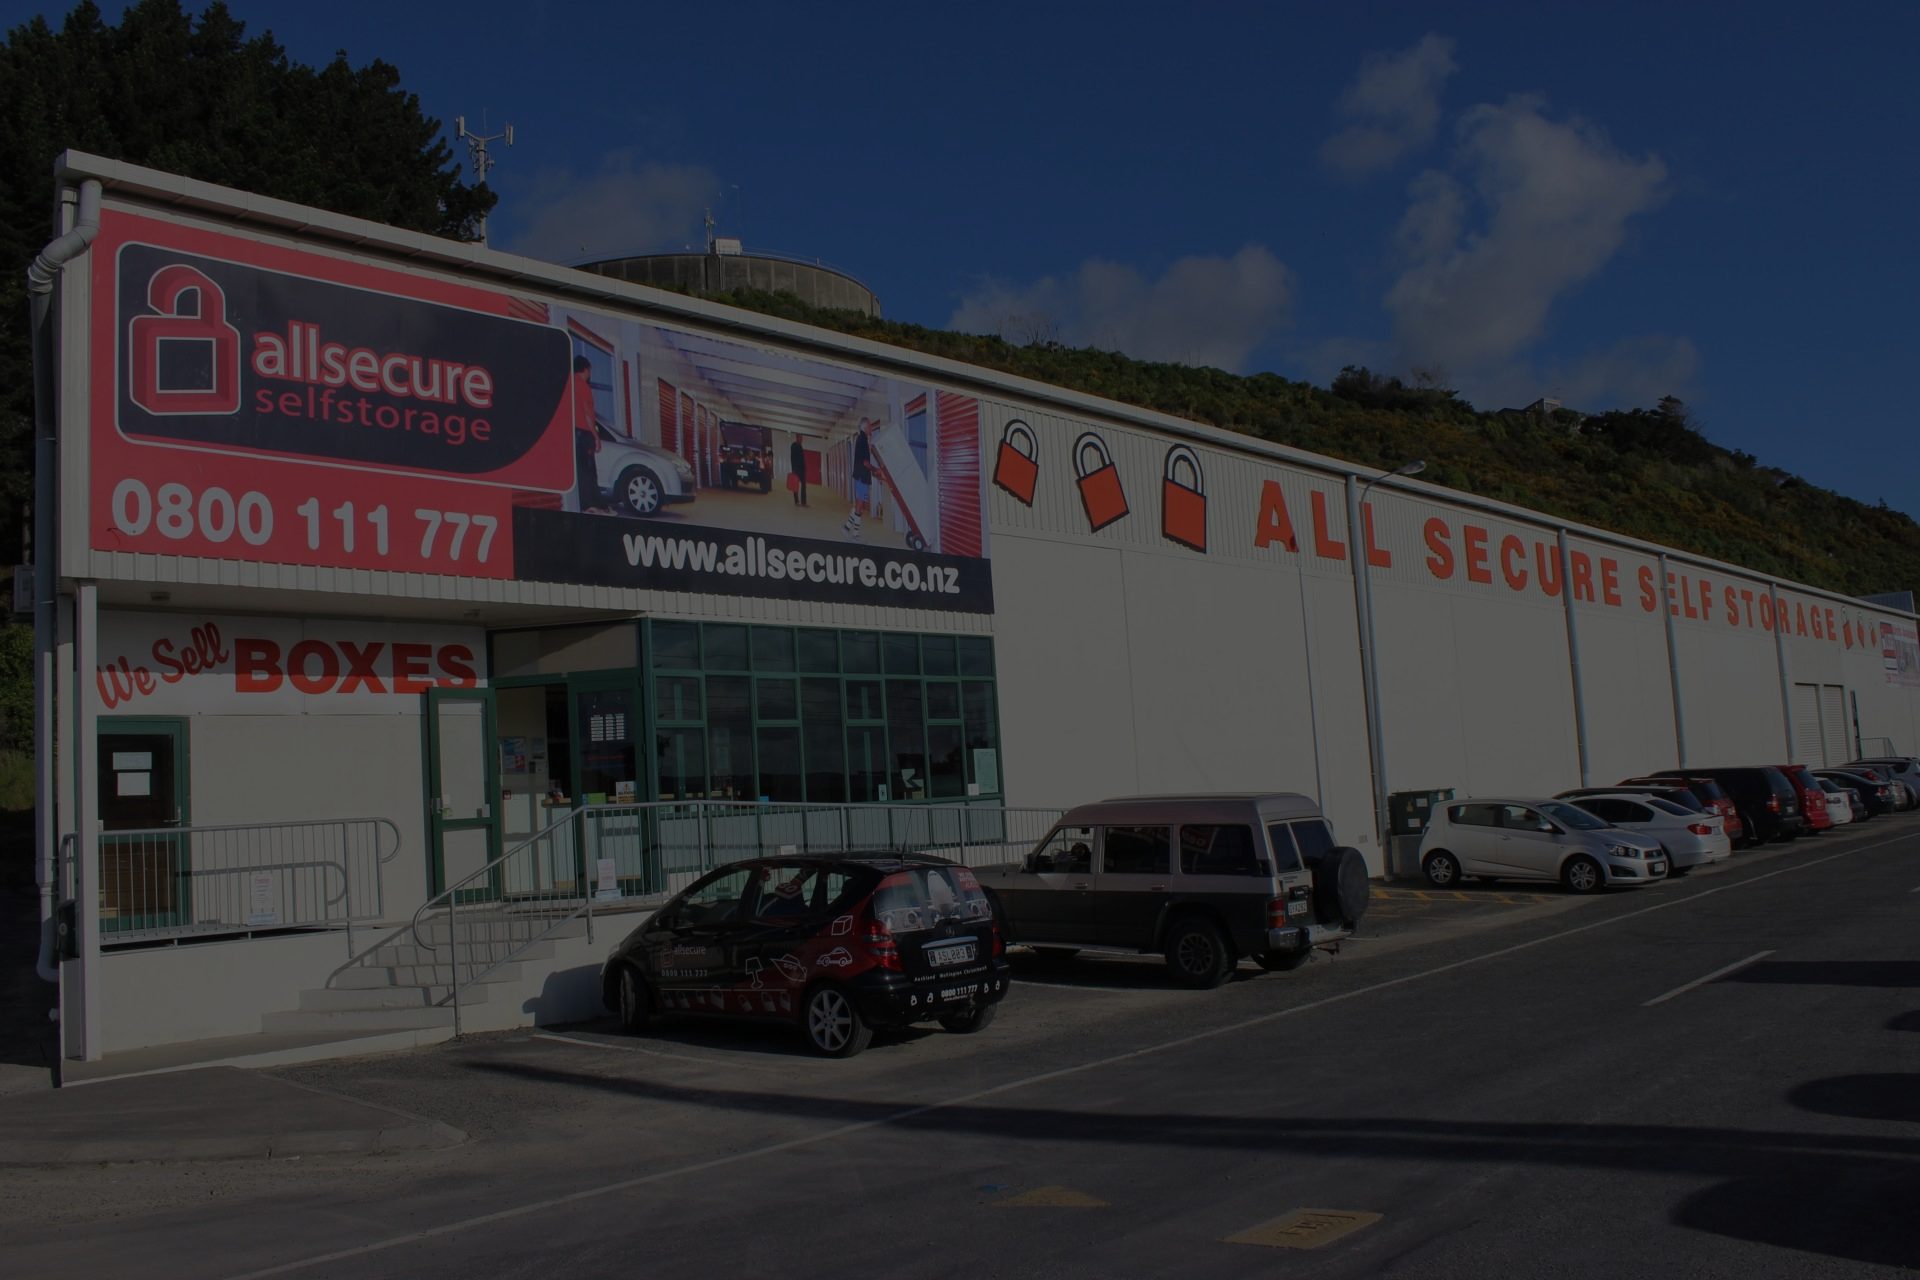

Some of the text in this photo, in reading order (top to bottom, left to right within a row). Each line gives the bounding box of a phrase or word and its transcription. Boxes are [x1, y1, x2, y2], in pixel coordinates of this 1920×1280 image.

[253, 321, 493, 408] allsecure
[256, 386, 490, 444] selfstorage
[112, 478, 498, 563] 0800 111 777
[622, 533, 960, 595] www.allsecure.co.nz
[1254, 480, 1391, 568] ALL
[1423, 517, 1621, 606] SECURE
[1724, 585, 1837, 641] STORAGE
[97, 622, 477, 709] We Sell BOXES
[680, 968, 693, 977] 111
[941, 984, 978, 997] 0800 111 777
